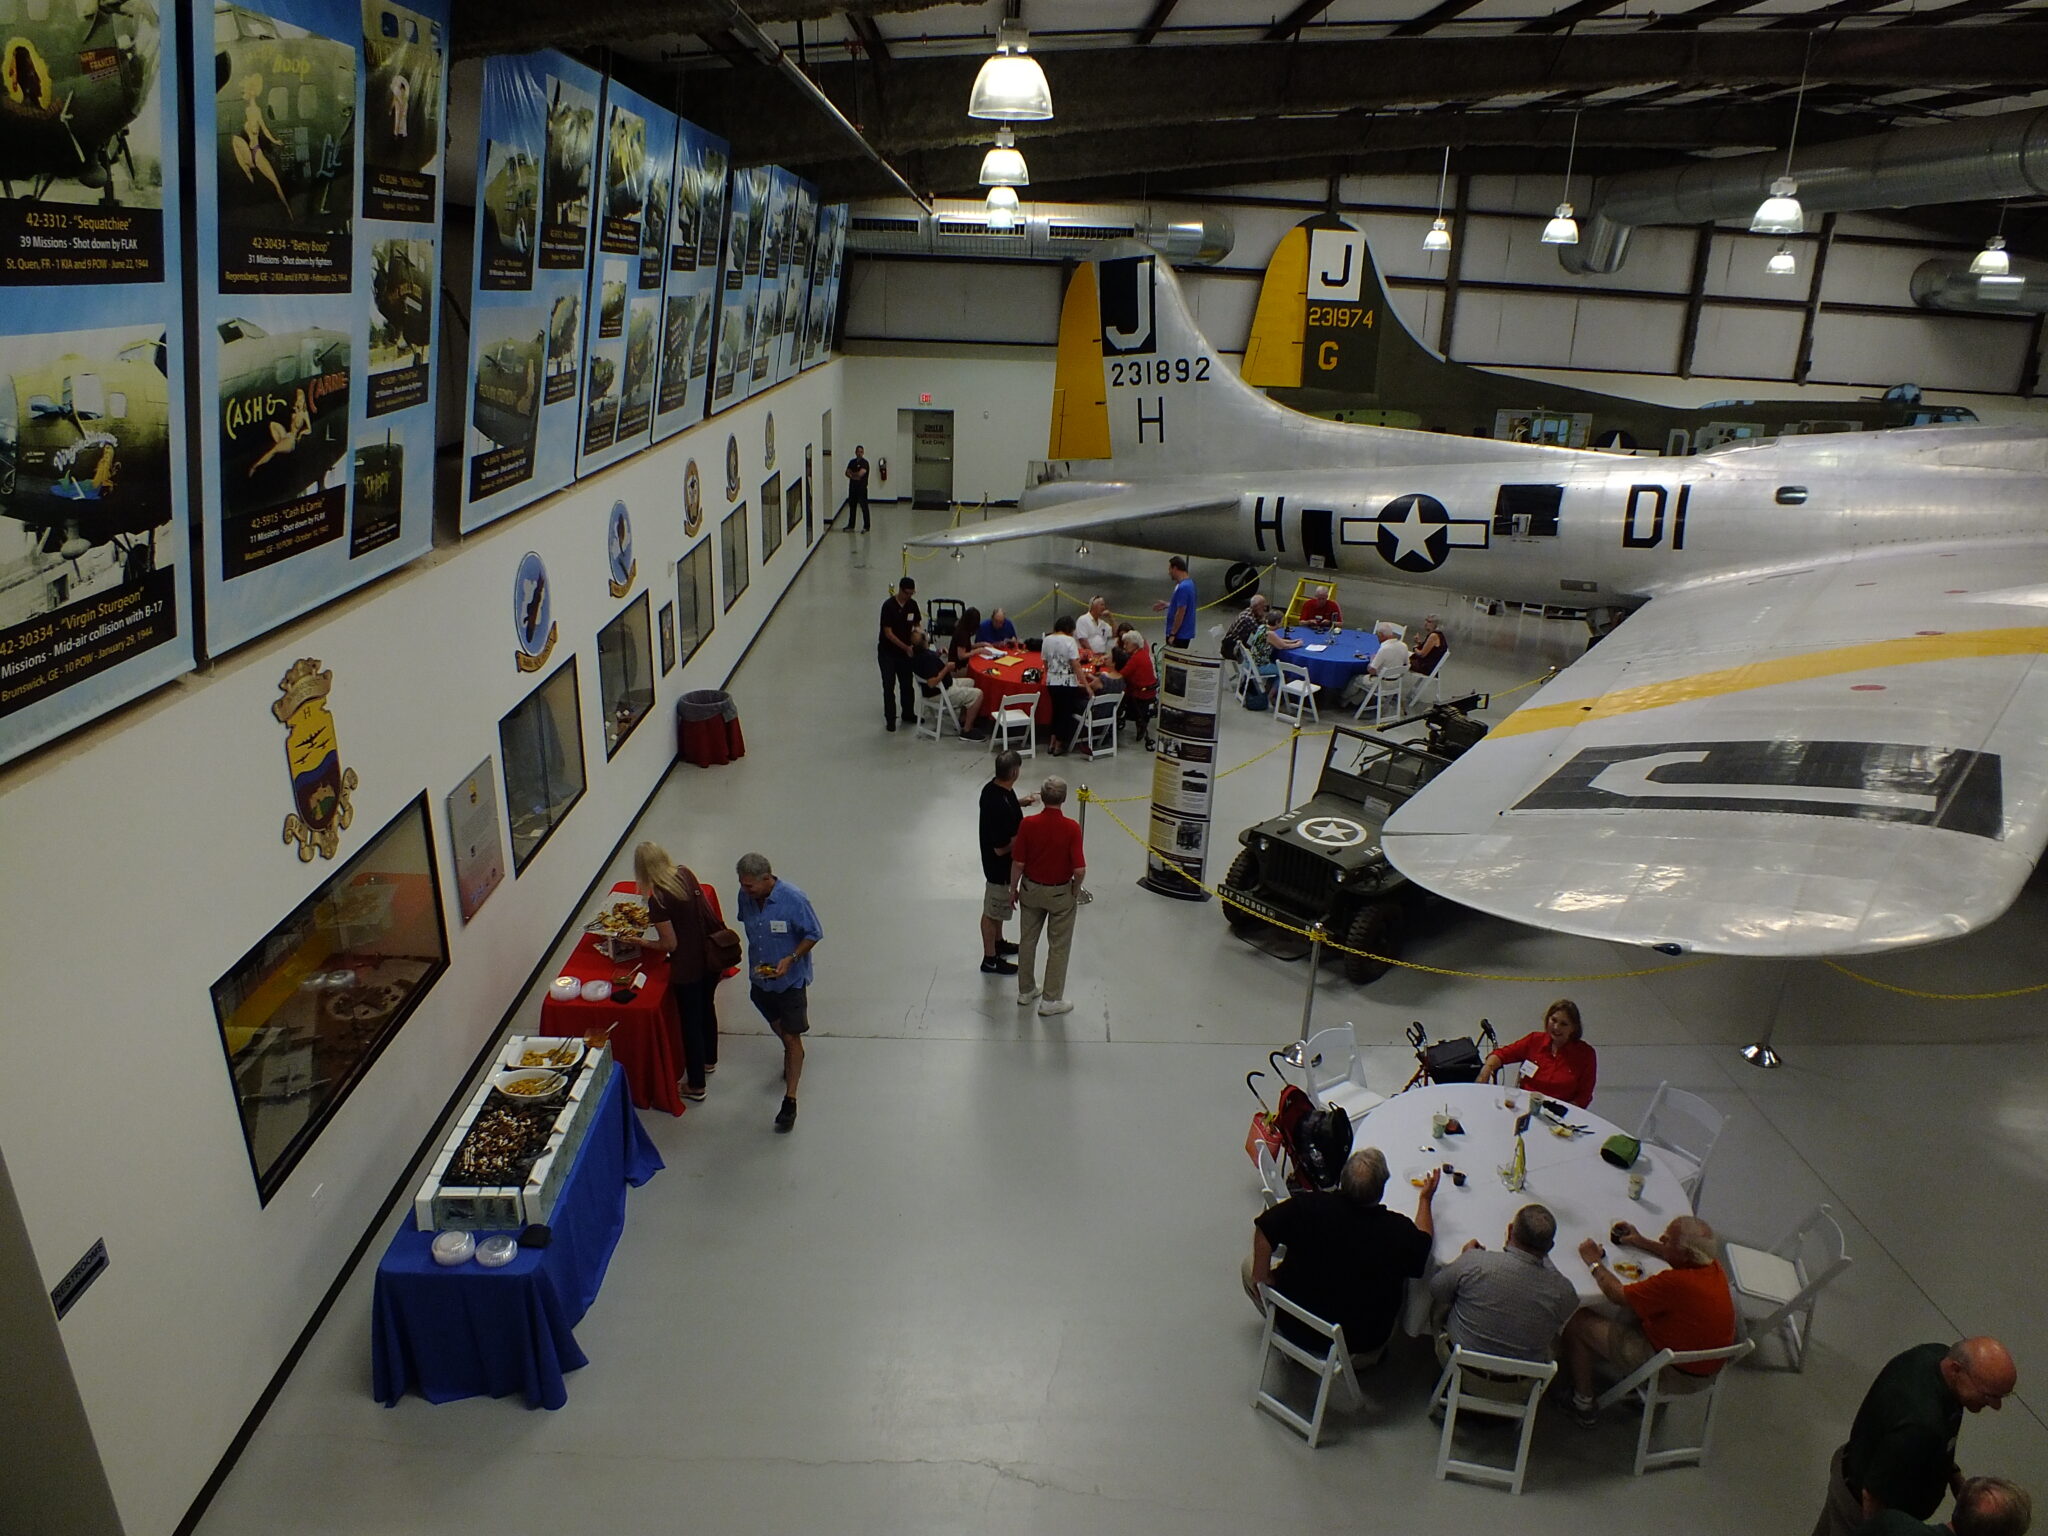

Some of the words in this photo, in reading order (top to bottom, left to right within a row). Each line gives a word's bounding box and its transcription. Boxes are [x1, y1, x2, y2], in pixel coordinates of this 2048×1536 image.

[25, 212, 68, 229] 42-3312
[19, 235, 32, 248] 39
[32, 236, 68, 249] Missions
[73, 237, 90, 249] Shot
[91, 238, 111, 250] down
[111, 238, 121, 251] by
[121, 239, 138, 250] FLAK
[73, 259, 87, 269] and
[92, 259, 108, 269] POW
[1321, 244, 1353, 288] J
[1105, 260, 1150, 350] J
[1308, 307, 1375, 330] 231974
[1112, 357, 1211, 388] 231892
[1318, 340, 1340, 371] G
[225, 396, 263, 440] CASH
[1137, 396, 1164, 444] H
[1254, 496, 1286, 552] H
[0, 623, 55, 657] 42-30334
[61, 608, 96, 630] "Virgin
[97, 586, 144, 617] Sturgeon"
[1, 652, 47, 679] Missions
[53, 633, 88, 657] Mid-air
[88, 618, 125, 642] collision
[125, 608, 145, 625] with
[144, 600, 163, 617] B-17
[48, 667, 59, 681] GE
[75, 652, 94, 670] POW
[98, 641, 125, 660] January
[54, 1242, 104, 1299] RESTROOMS
